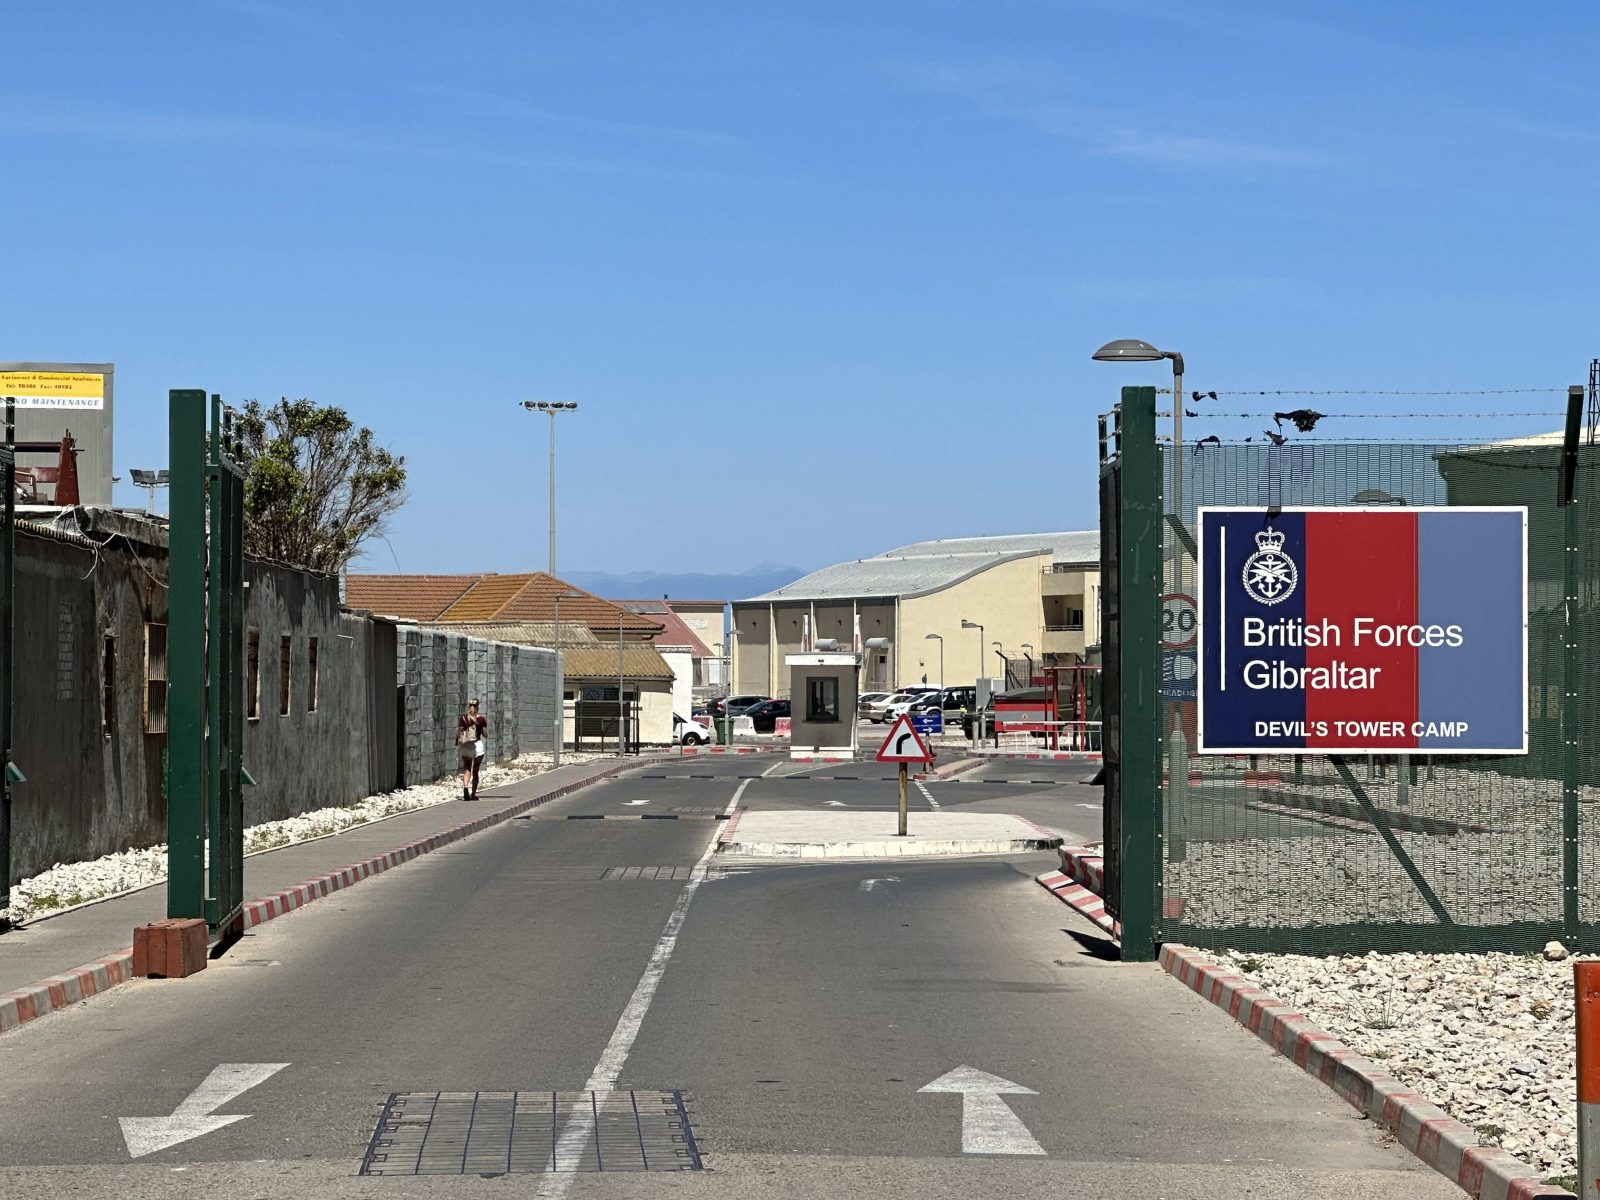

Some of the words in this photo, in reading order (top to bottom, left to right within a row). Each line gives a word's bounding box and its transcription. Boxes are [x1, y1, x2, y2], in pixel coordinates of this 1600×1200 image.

[31, 398, 100, 407] MAINTENANCE
[1162, 608, 1197, 632] 20
[1243, 617, 1342, 647] British
[1353, 617, 1465, 647] Forces
[1243, 659, 1382, 690] Gibraltar
[1255, 721, 1329, 738] DEVIL'S
[1333, 721, 1406, 738] TOWER
[1411, 721, 1469, 738] CAMP
